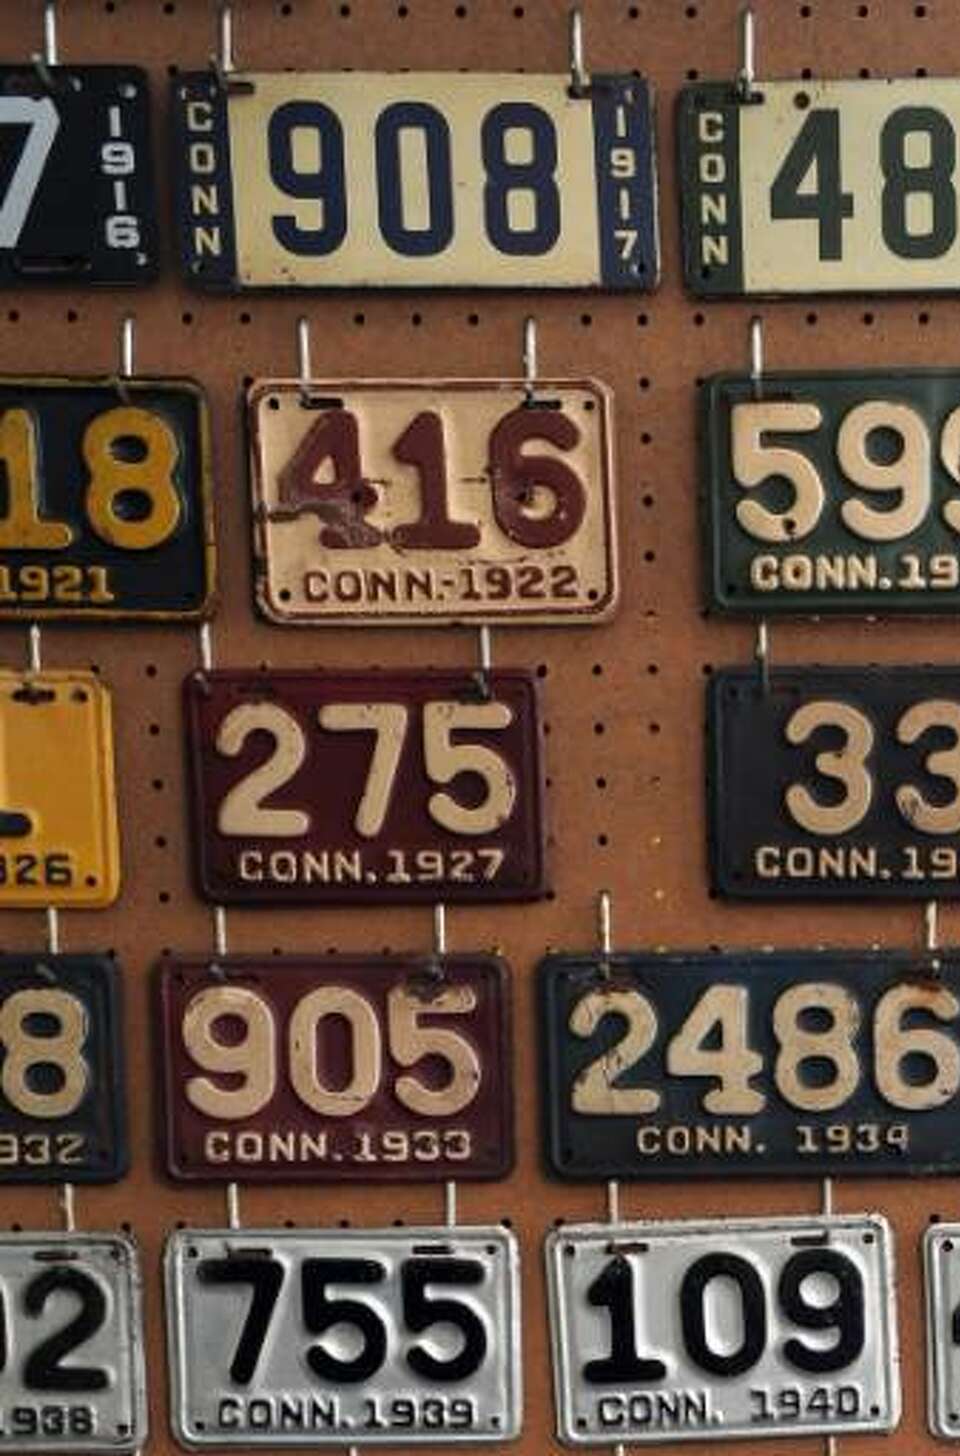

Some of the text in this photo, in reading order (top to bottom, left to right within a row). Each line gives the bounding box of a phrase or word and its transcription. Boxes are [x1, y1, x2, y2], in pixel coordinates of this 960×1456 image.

[0, 95, 61, 249] 7
[100, 106, 141, 250] 1916
[186, 101, 222, 257] CONN
[267, 100, 562, 257] 908
[610, 106, 639, 260] 1917
[699, 112, 728, 265] CONN
[0, 406, 179, 551] 18
[278, 406, 587, 550] 416
[215, 701, 516, 837] 275
[0, 987, 89, 1118] 8
[182, 985, 482, 1119] 905
[636, 1124, 909, 1155] CONN. 1934
[0, 1266, 108, 1391] 2
[197, 1258, 487, 1385] 755
[584, 1250, 865, 1383] 109
[0, 1405, 94, 1434] 938
[598, 1387, 861, 1426] CONN. 1940
